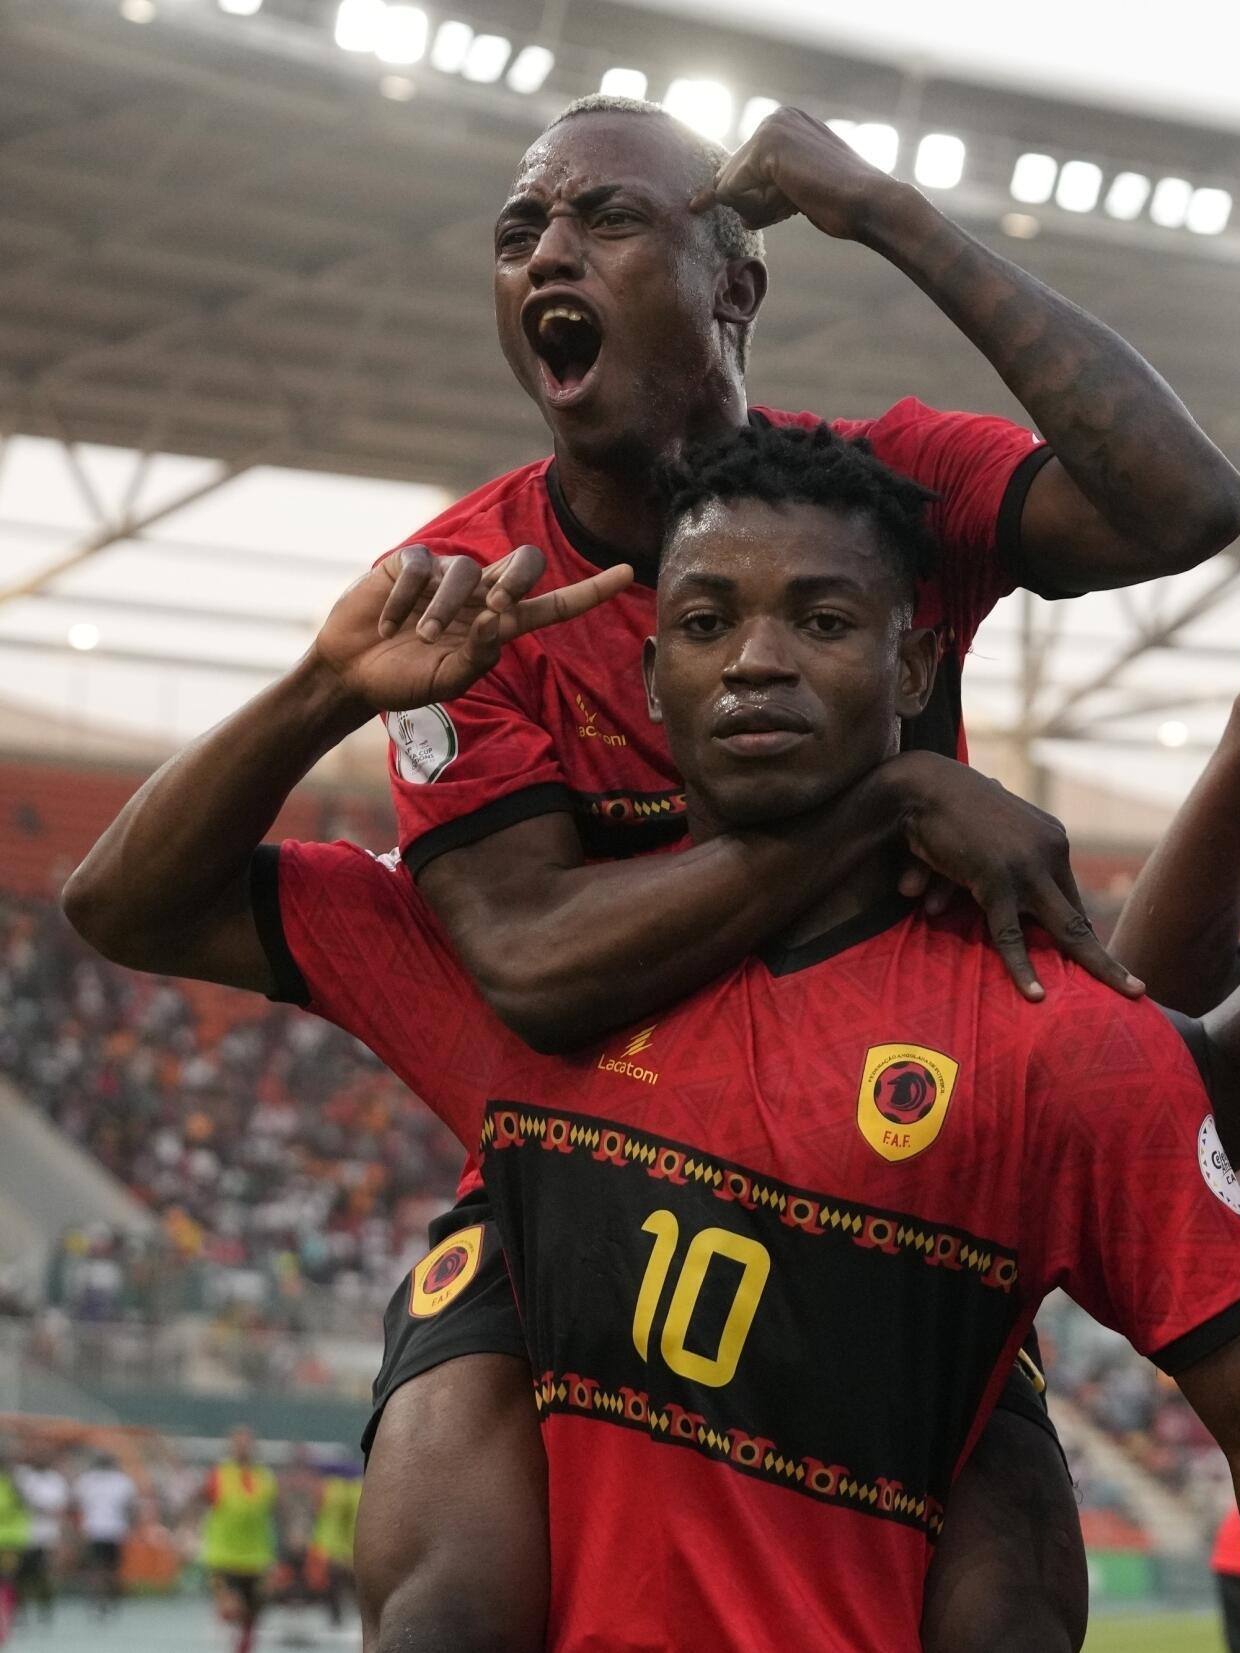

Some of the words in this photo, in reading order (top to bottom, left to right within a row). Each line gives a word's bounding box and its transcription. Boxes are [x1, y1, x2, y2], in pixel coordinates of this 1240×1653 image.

[597, 1053, 659, 1085] Lacatoni
[882, 1130, 911, 1148] F.A.F.
[632, 1209, 771, 1387] 10
